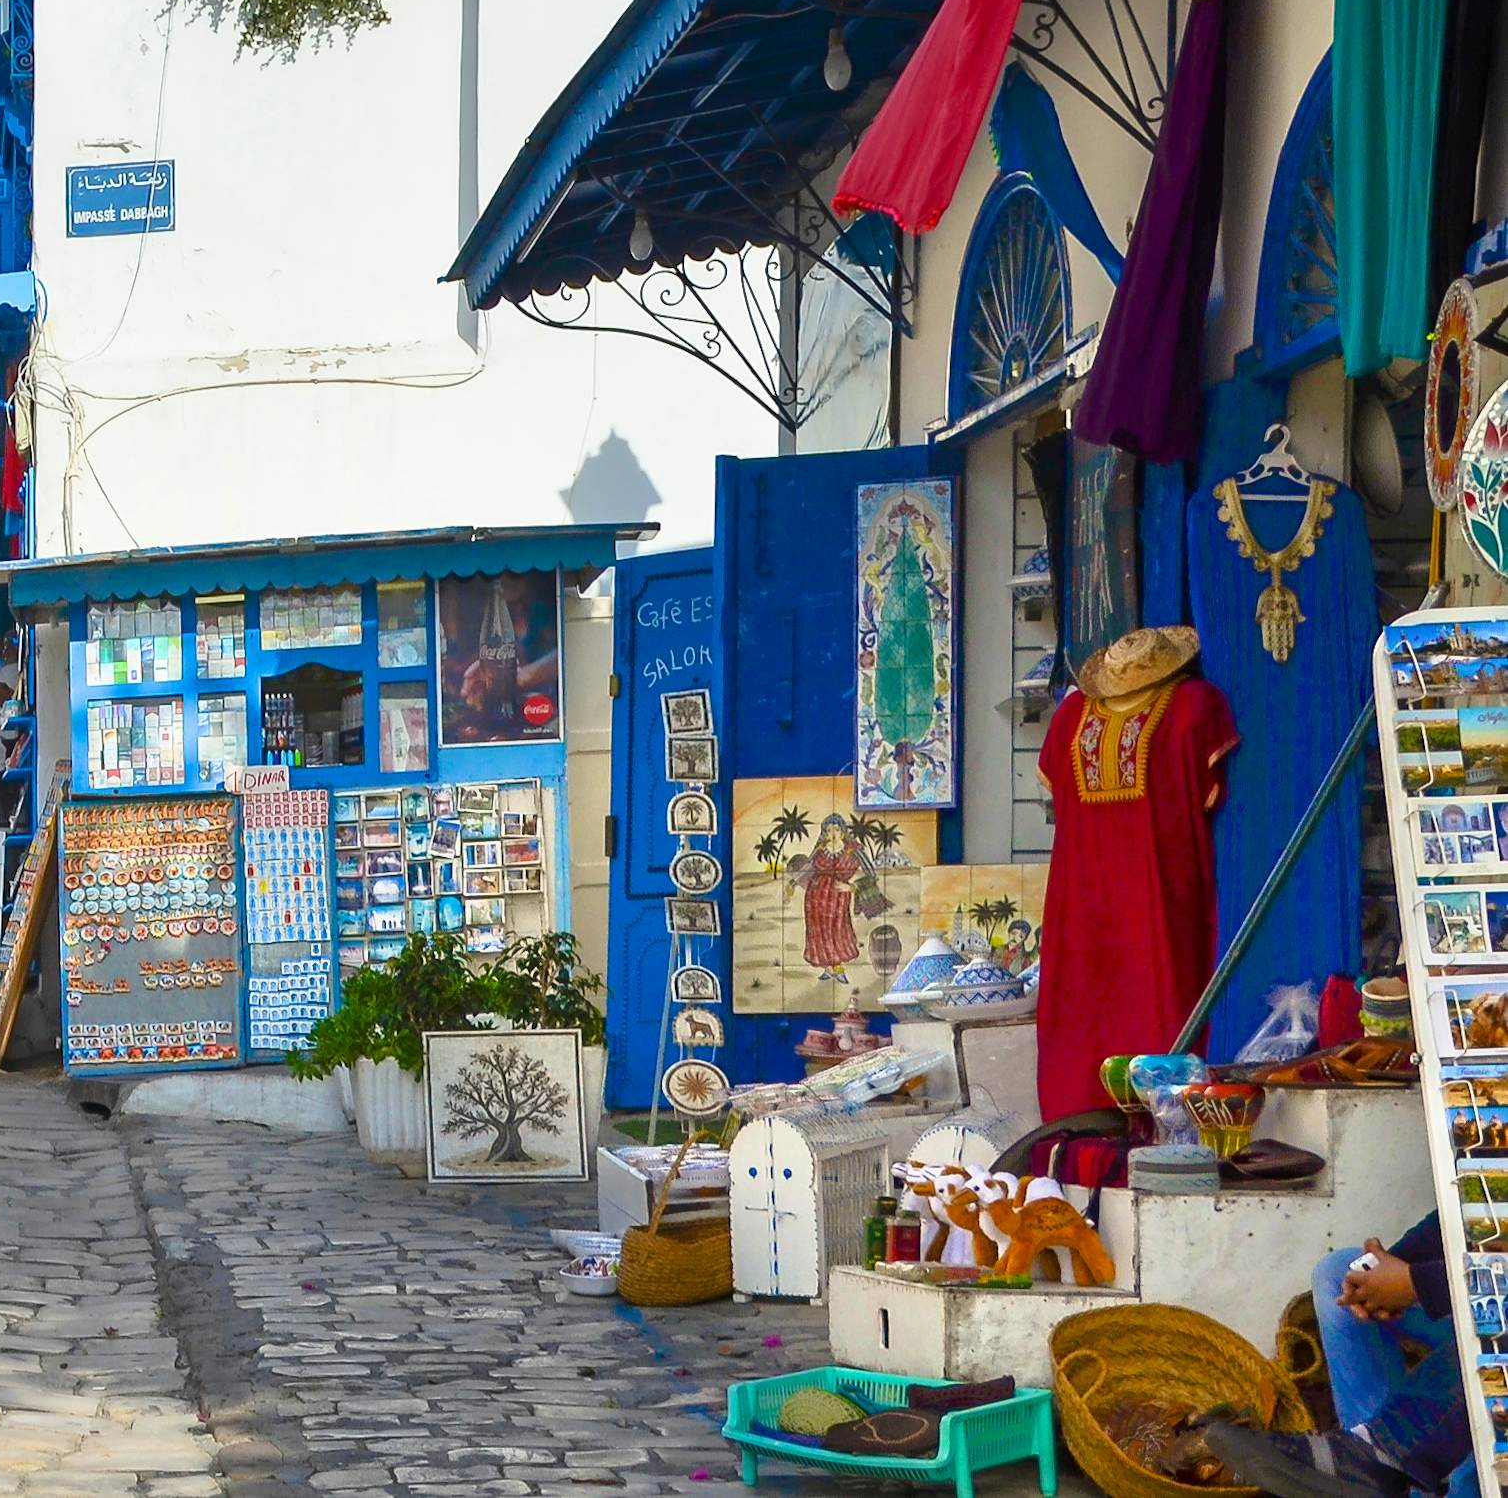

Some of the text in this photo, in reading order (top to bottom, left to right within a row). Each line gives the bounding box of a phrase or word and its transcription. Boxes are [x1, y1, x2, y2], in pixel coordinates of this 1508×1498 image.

[73, 205, 169, 224] IMPASSE DABBAGH
[244, 770, 285, 790] DINAR
